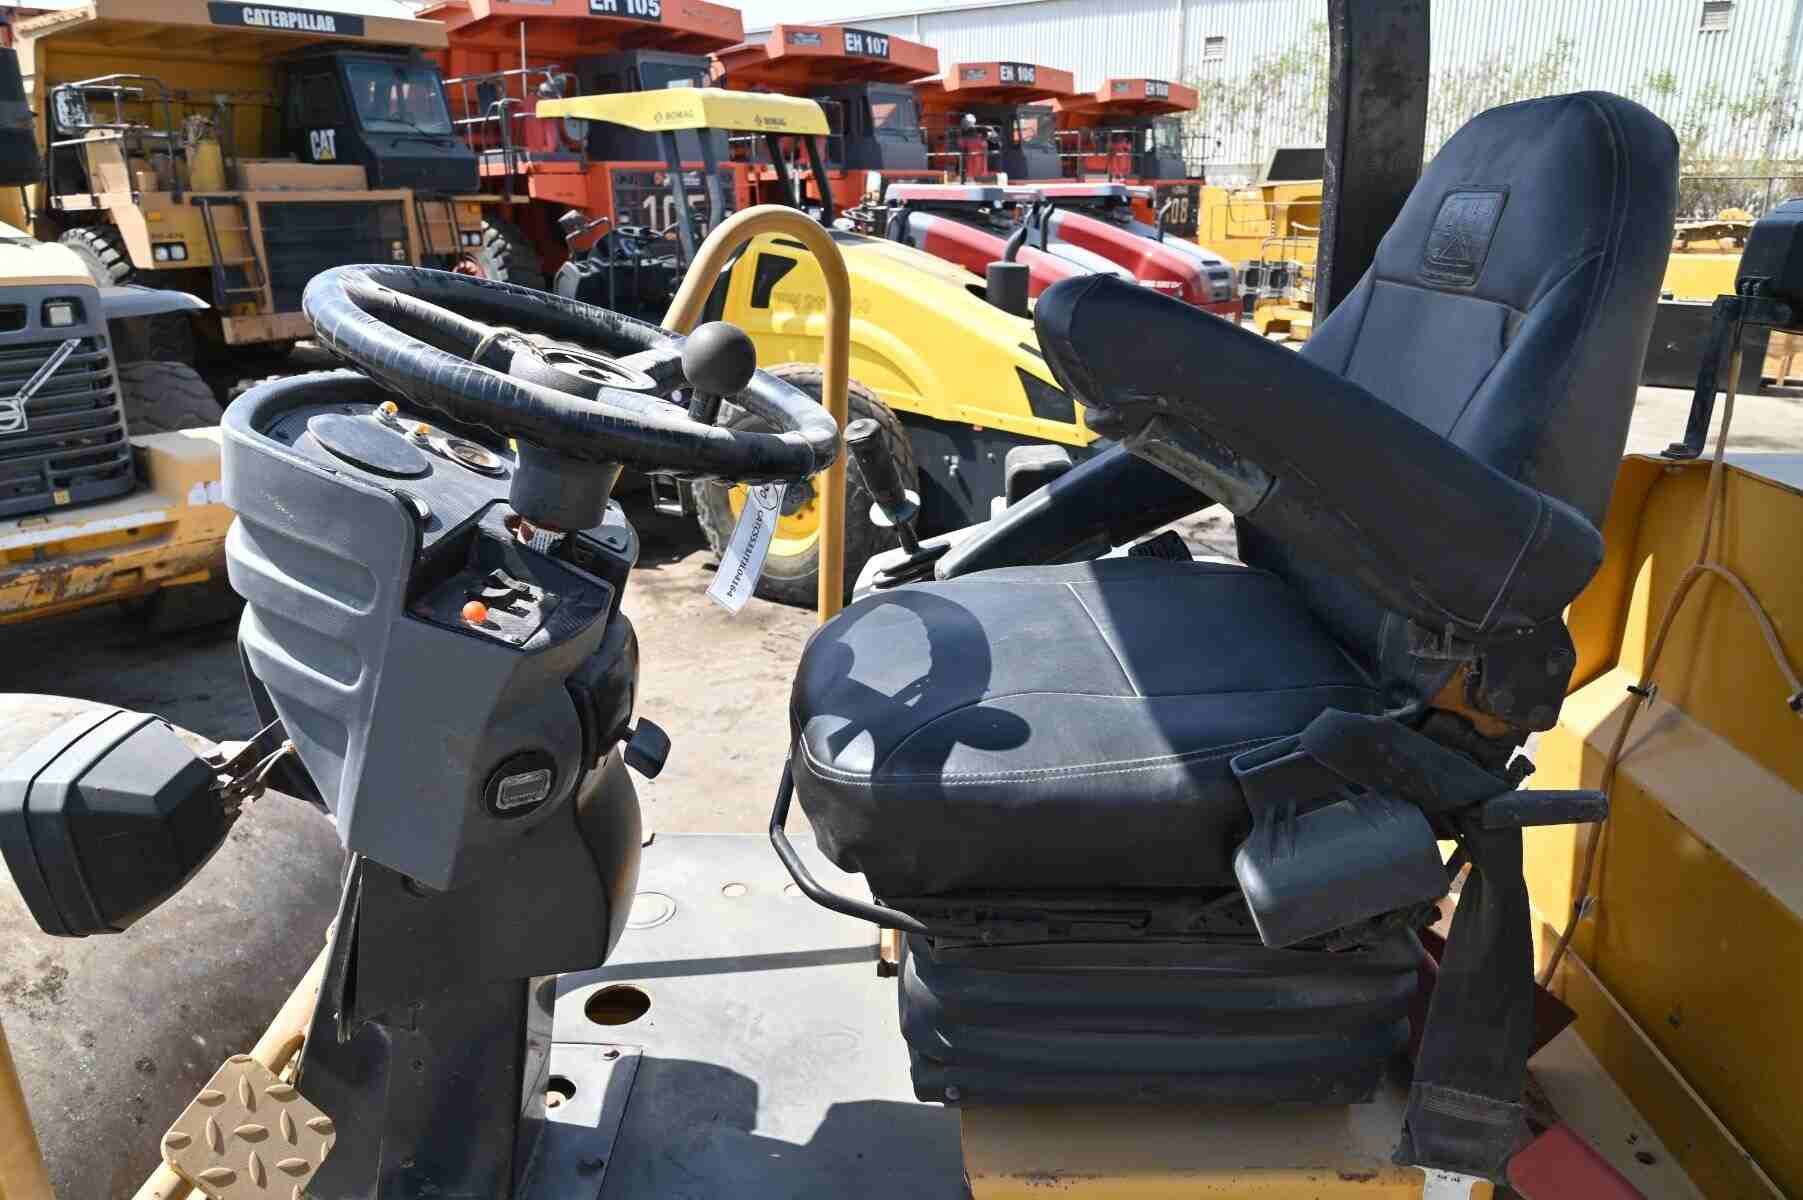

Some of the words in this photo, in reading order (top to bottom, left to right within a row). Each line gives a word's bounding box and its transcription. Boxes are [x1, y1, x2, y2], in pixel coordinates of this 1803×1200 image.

[242, 7, 336, 32] CATERPILLAR
[845, 33, 862, 52] EH
[866, 36, 888, 56] 107
[1000, 65, 1014, 80] EH
[310, 129, 336, 160] CAT
